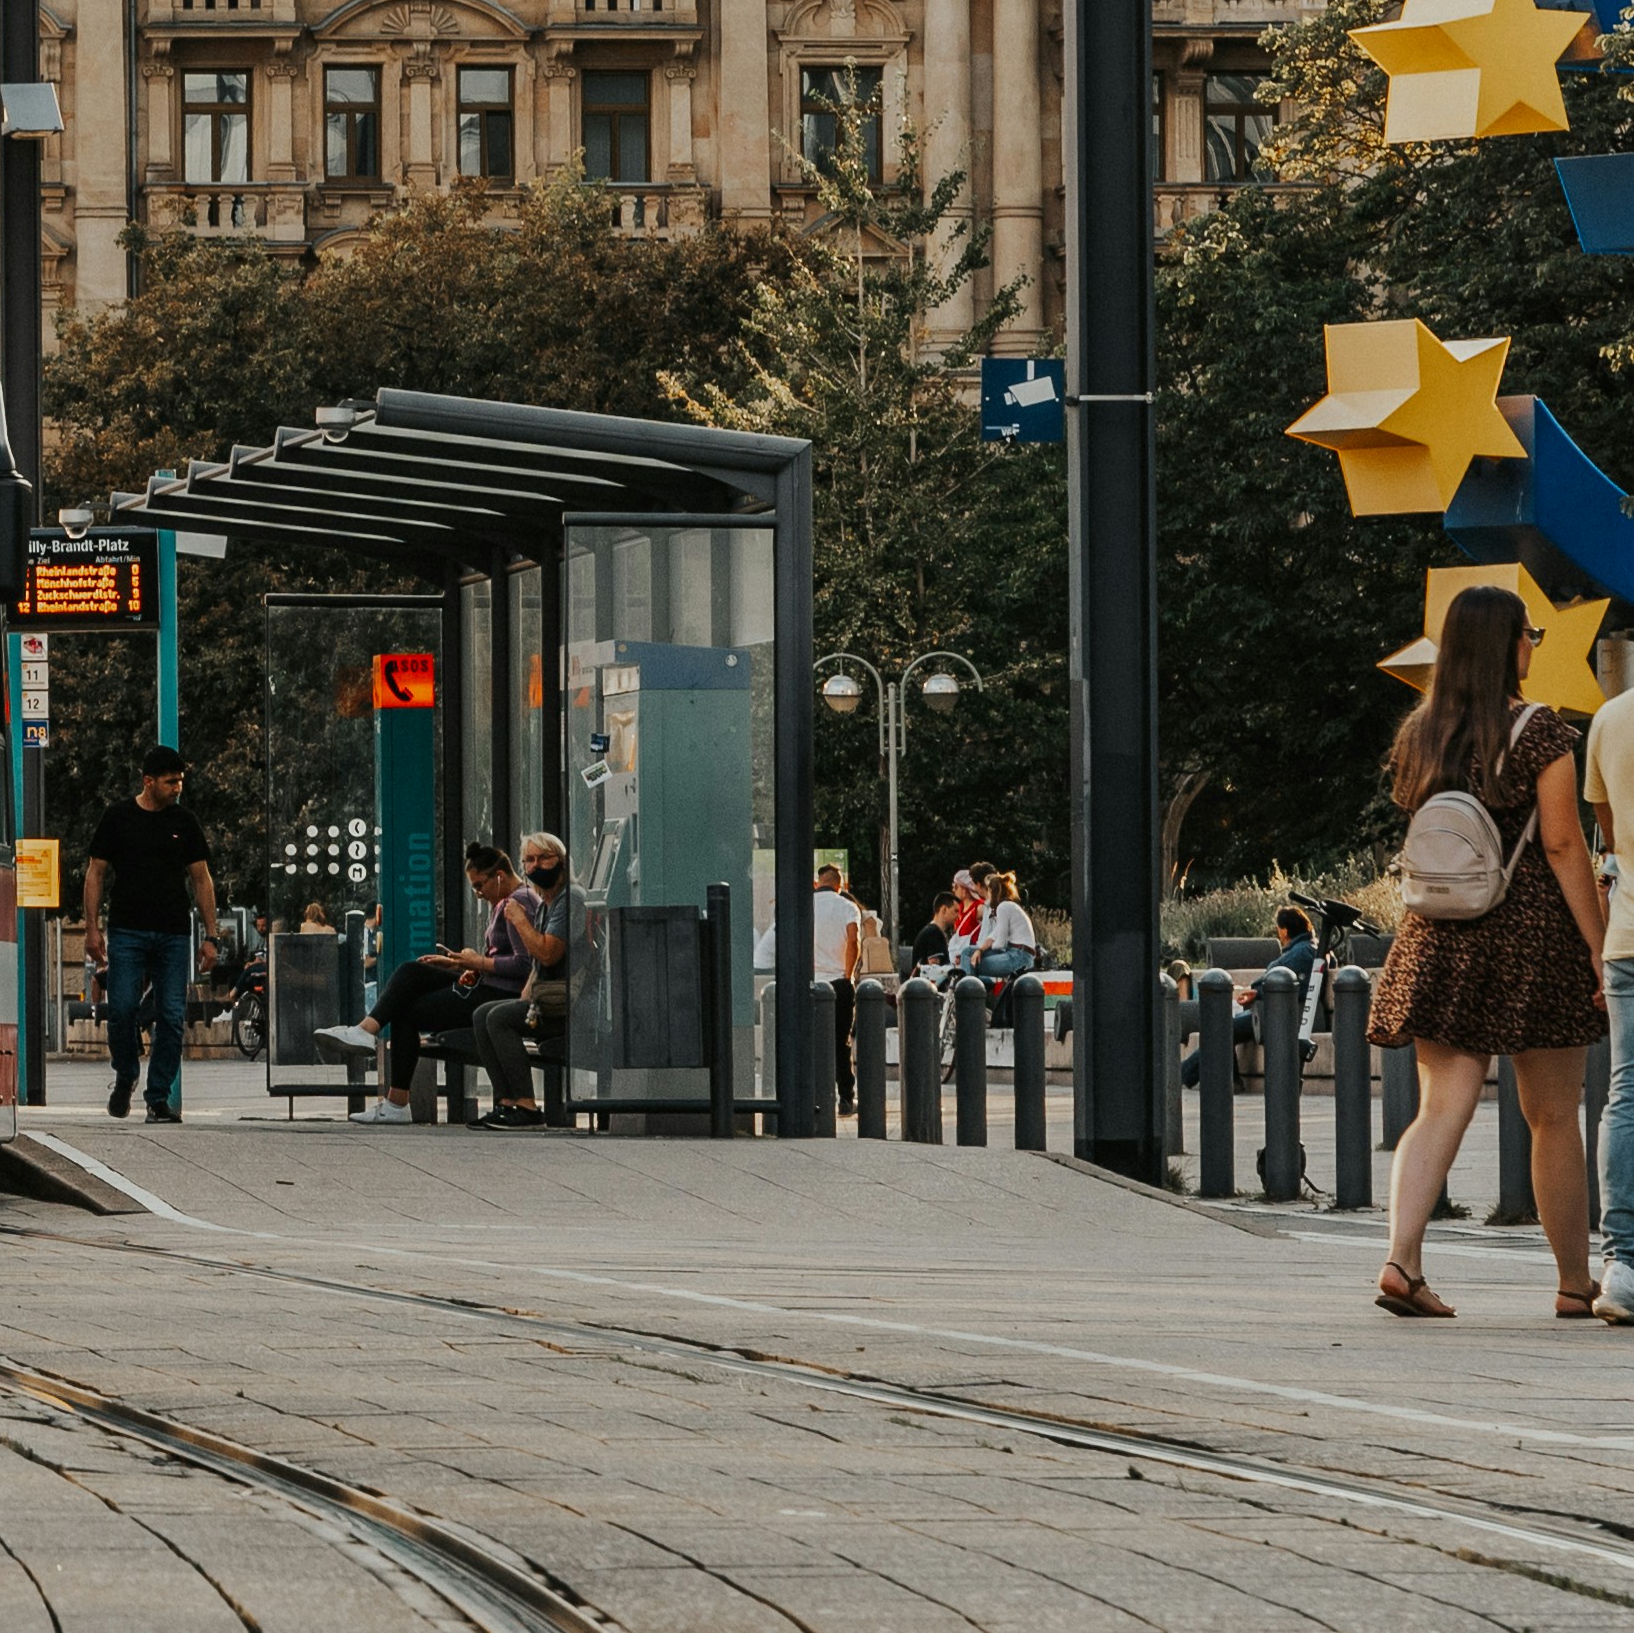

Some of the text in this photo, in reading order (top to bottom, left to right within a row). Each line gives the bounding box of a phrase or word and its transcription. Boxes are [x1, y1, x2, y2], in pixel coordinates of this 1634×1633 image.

[29, 539, 129, 555] illy-Brandt-Platz
[26, 669, 38, 681] 11
[27, 698, 40, 710] 12
